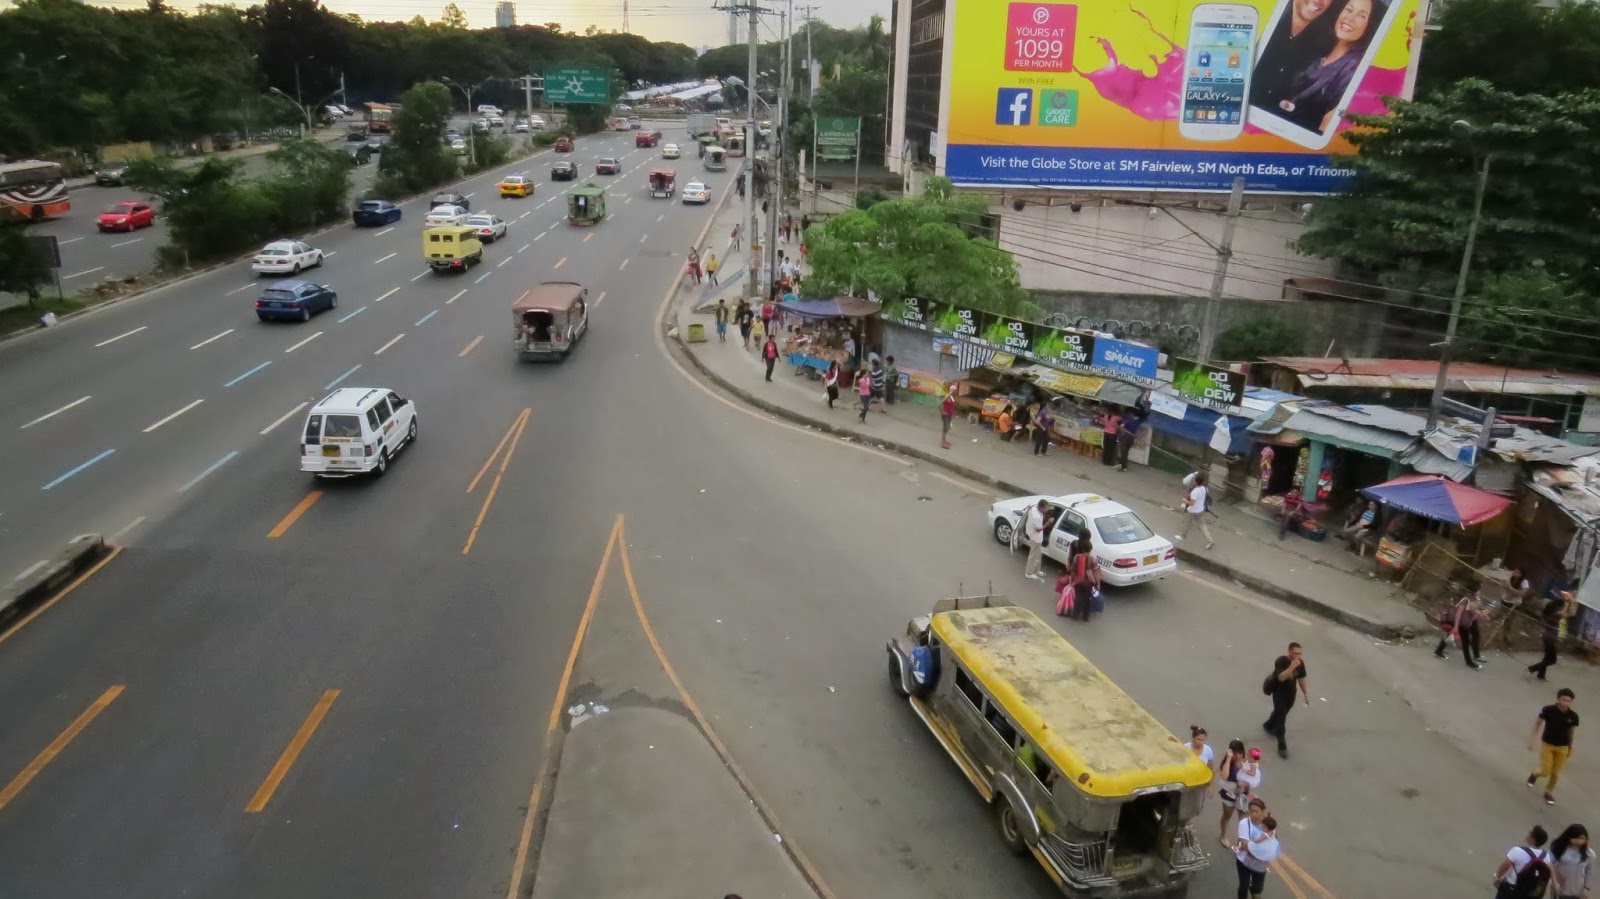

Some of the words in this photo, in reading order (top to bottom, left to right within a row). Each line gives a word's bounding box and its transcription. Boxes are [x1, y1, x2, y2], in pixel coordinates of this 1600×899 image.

[1016, 27, 1050, 37] YOURS
[1052, 28, 1065, 37] AT
[1014, 39, 1062, 58] 1099
[1014, 59, 1030, 67] PER
[1031, 60, 1062, 68] MONTH
[1187, 92, 1220, 101] GALAXY
[1045, 115, 1070, 124] CARE
[981, 156, 1006, 168] Visit
[1009, 156, 1029, 168] the
[1031, 157, 1067, 170] Globe
[1069, 158, 1101, 171] Store
[1103, 160, 1116, 171] at
[1119, 160, 1138, 171] SM
[1141, 160, 1194, 175] Fairview,
[1197, 162, 1216, 174] SM
[1218, 163, 1255, 175] North
[1257, 164, 1289, 177] Edsa,
[1291, 166, 1305, 176] or
[1308, 165, 1357, 177] Trinoma
[904, 297, 918, 306] DO
[902, 311, 923, 321] DEW
[958, 309, 972, 319] DO
[962, 317, 974, 325] THE
[955, 323, 977, 335] DEW
[1007, 322, 1022, 331] DO
[1013, 330, 1026, 339] THE
[1063, 335, 1080, 344] DO
[1005, 336, 1029, 348] DEW
[1069, 343, 1083, 352] THE
[1060, 350, 1087, 362] DEW
[1104, 350, 1145, 369] SMART
[1208, 371, 1228, 382] DO
[1215, 381, 1231, 391] THE
[1204, 387, 1236, 402] DEW
